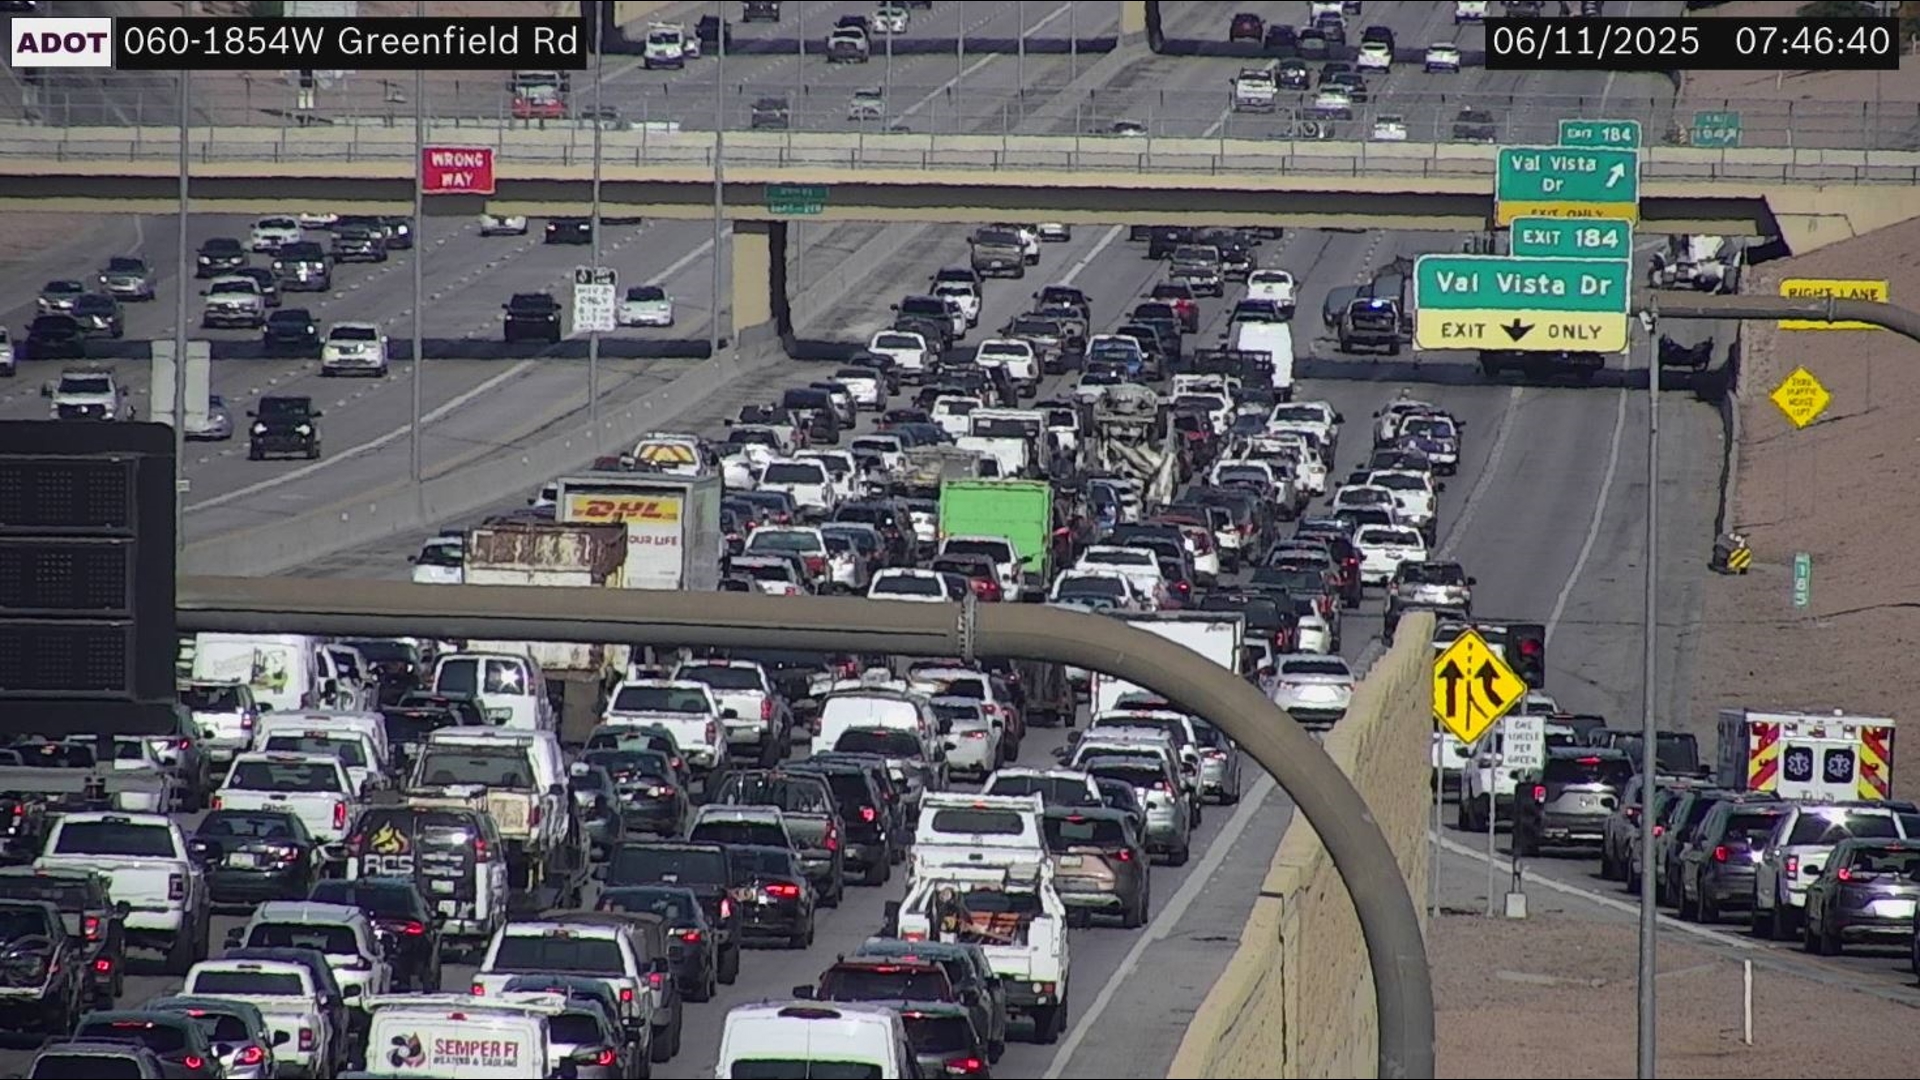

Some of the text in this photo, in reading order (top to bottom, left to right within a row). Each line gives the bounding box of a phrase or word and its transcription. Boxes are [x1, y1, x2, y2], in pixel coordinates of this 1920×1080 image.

[1567, 128, 1631, 141] EXIT 184
[431, 152, 484, 168] WRONG
[1511, 155, 1597, 171] Val Vista
[441, 171, 473, 187] WAY
[1542, 177, 1564, 192] Dr
[1523, 228, 1619, 248] EXIT 184
[1437, 271, 1613, 296] Val Vista Dr
[1788, 287, 1833, 298] RIGHT
[1441, 322, 1602, 340] EXIT ONLY
[584, 500, 661, 519] DHL
[654, 536, 678, 546] LIFE
[363, 854, 414, 875] RCS
[434, 1038, 518, 1058] SEMPER FI
